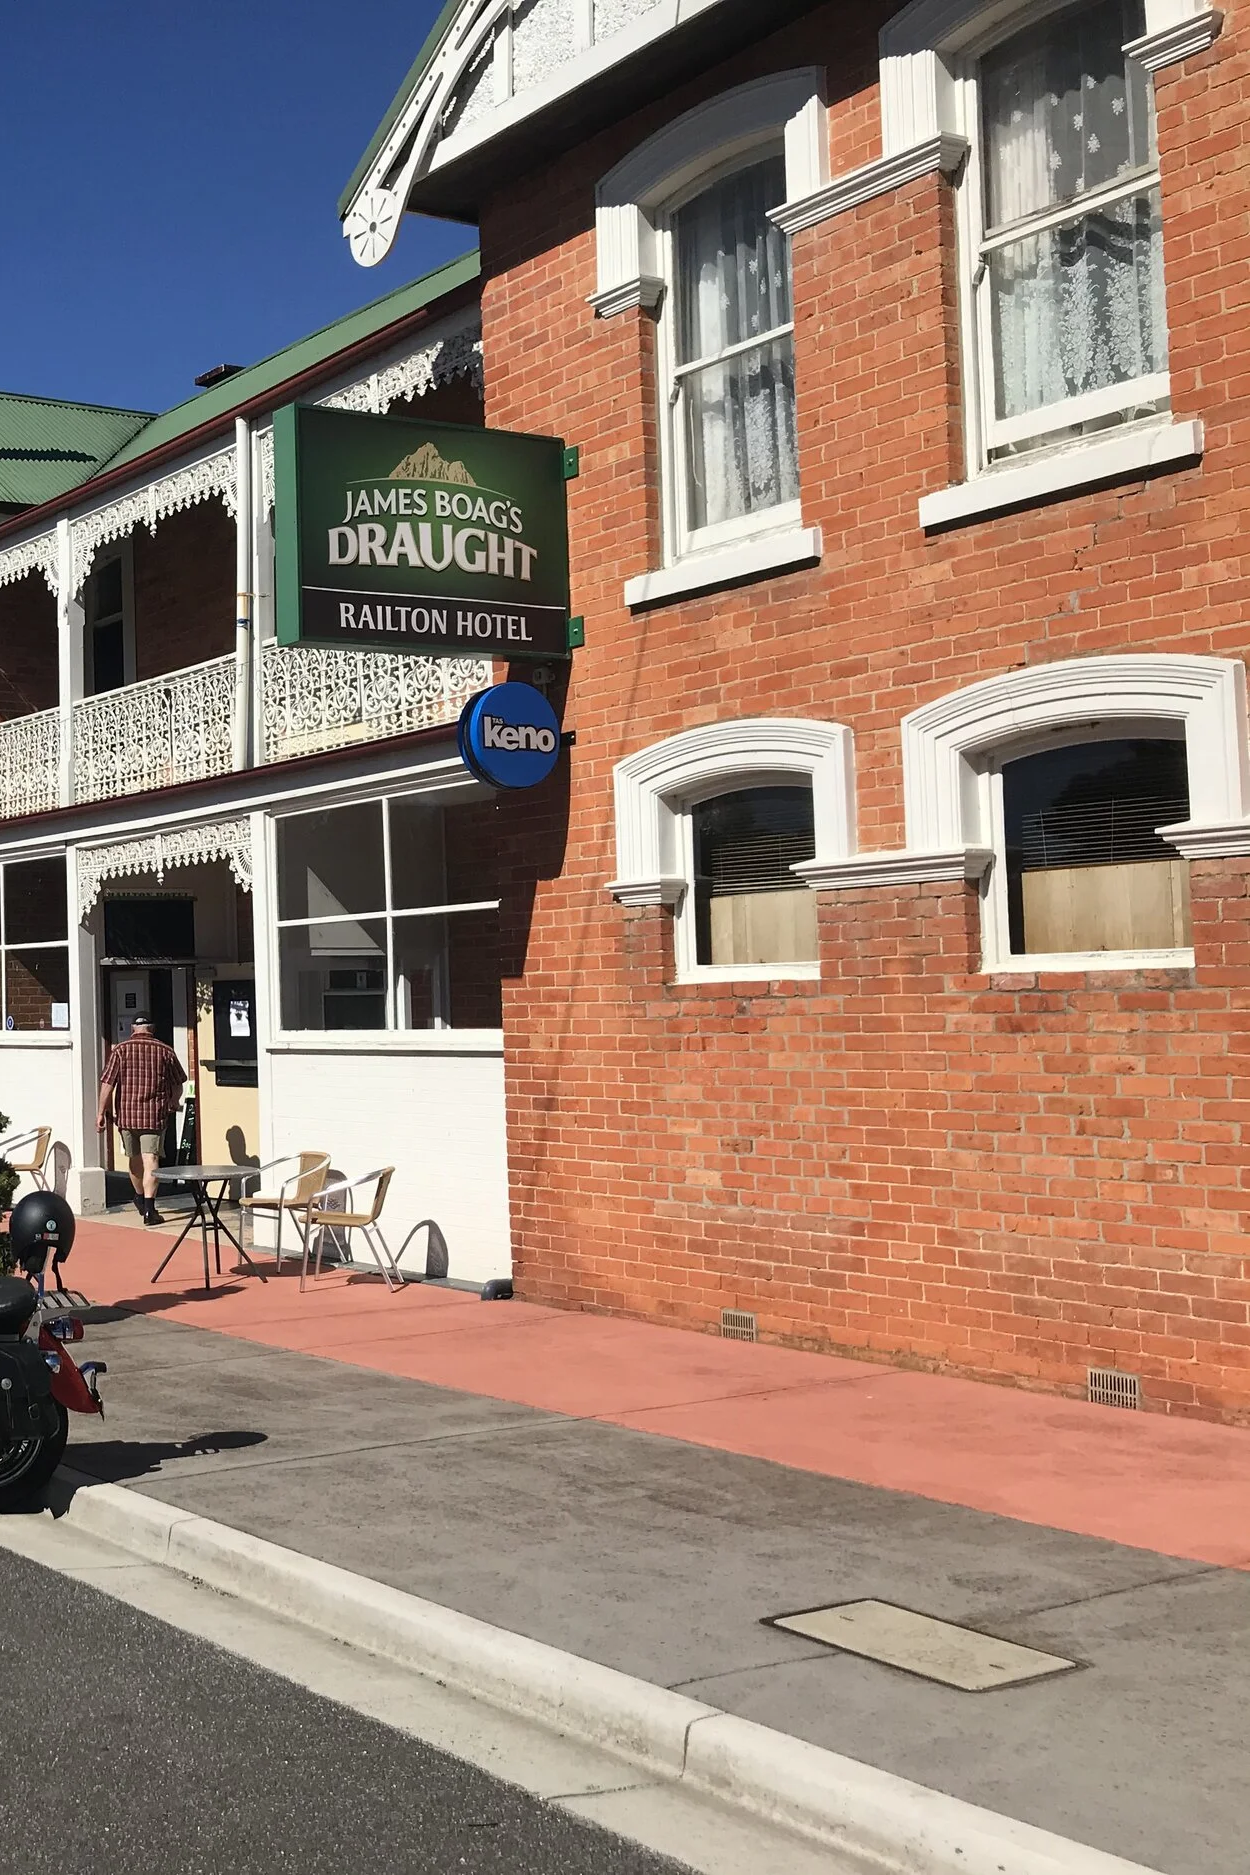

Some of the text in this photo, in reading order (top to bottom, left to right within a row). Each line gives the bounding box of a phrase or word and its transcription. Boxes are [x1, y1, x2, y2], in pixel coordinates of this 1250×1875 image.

[342, 488, 522, 534] JAMES BOAG'S
[328, 521, 538, 582] DRAUGHT
[339, 602, 533, 642] RAILTON HOTEL
[483, 716, 556, 753] keno
